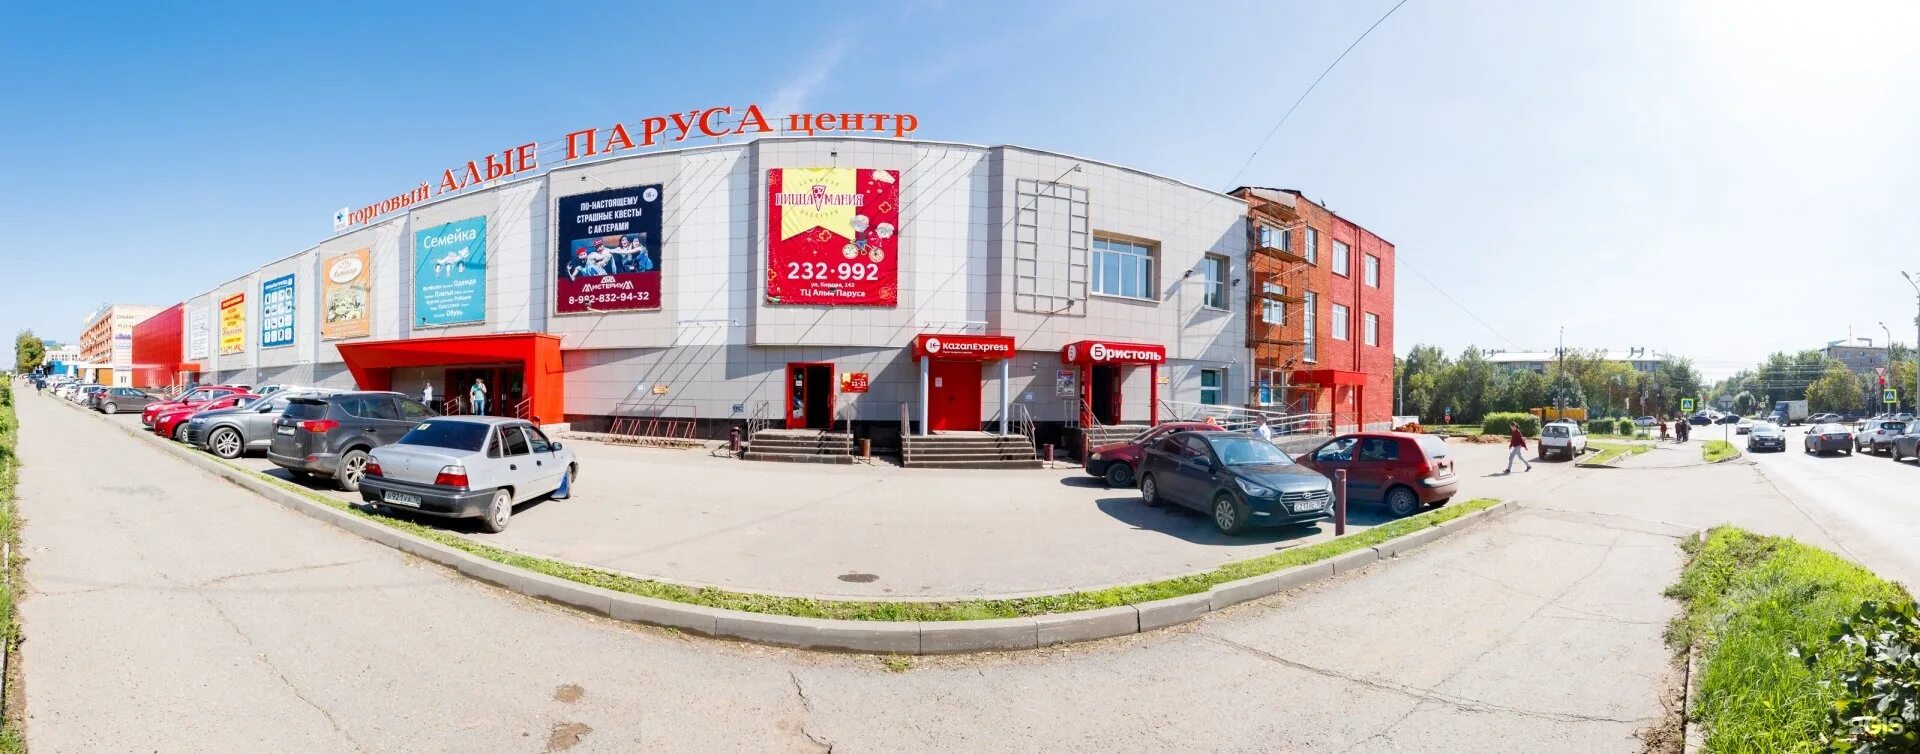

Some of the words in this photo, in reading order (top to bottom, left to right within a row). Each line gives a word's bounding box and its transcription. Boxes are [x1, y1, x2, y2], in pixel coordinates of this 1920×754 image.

[348, 182, 430, 226] торговый
[438, 142, 537, 194] АЛЫЕ
[565, 104, 774, 160] ПАРУСА
[789, 112, 918, 137] центр
[580, 196, 638, 211] ПО-НАСТОЯЩЕМУ
[576, 212, 613, 223] СТРАШНЫЕ
[614, 208, 642, 219] КВЕСТЫ
[588, 226, 593, 234] С
[593, 222, 629, 233] АКТЕРАМИ
[423, 228, 476, 249] Семейка
[568, 291, 650, 305] 8-982-832-94-32
[800, 289, 812, 298] ТЦ
[943, 342, 1009, 352] KazanExpress
[1094, 346, 1162, 361] Бристоль
